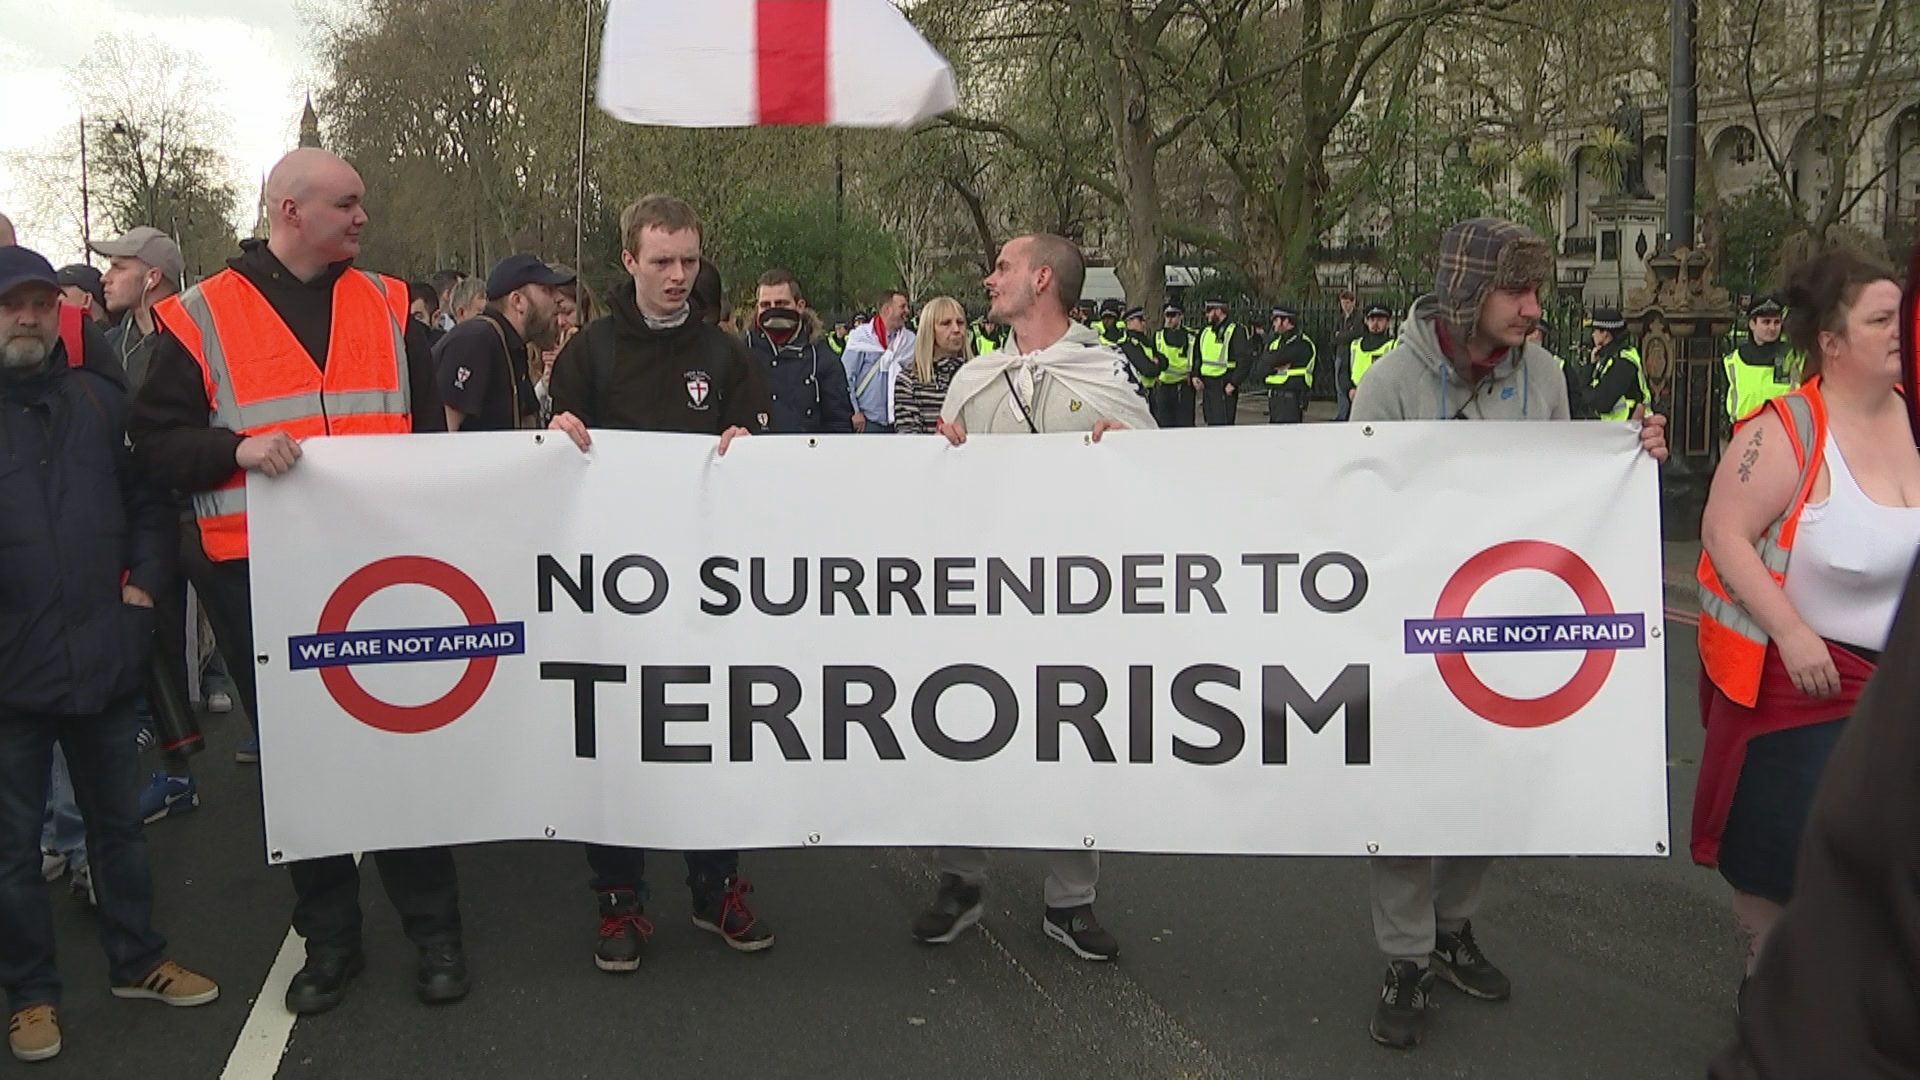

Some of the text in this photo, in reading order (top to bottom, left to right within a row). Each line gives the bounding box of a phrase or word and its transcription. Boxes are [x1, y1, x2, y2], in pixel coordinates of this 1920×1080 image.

[537, 552, 1369, 617] NO SURRENDER TO
[299, 632, 515, 660] WE ARE NOT AFRAID
[1414, 622, 1635, 645] WE ARE NOT AFRAID
[539, 661, 1371, 766] TERRORISM
